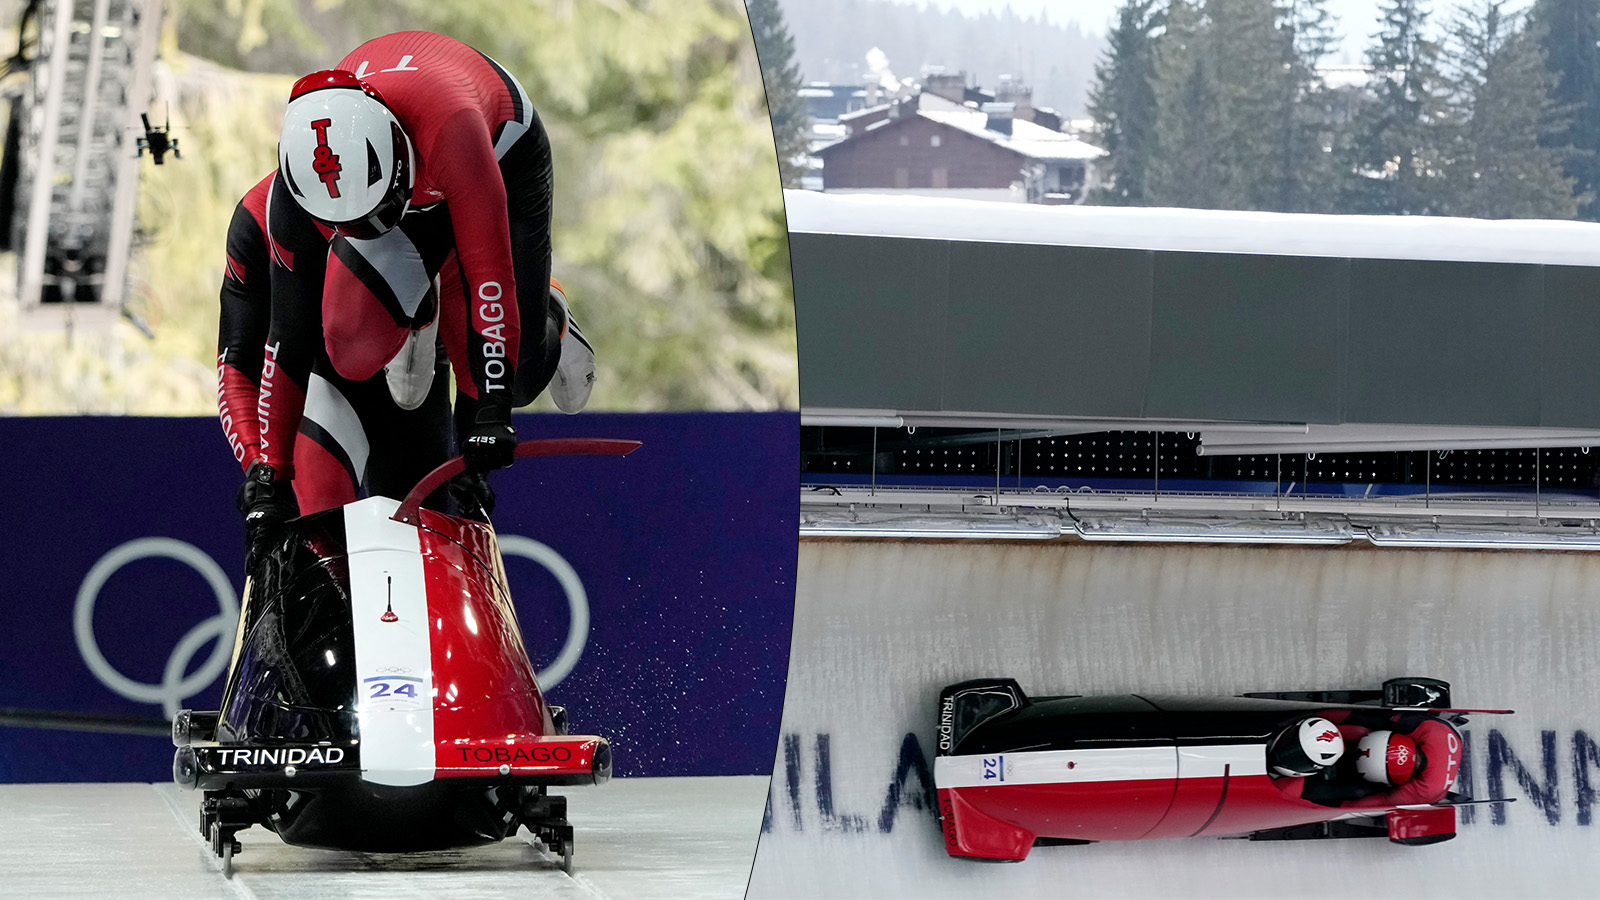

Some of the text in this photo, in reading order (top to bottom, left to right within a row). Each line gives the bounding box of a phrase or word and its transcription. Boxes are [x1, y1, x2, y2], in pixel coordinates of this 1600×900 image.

[310, 117, 343, 199] T&T
[478, 281, 507, 393] TOBAGO
[468, 436, 497, 445] SEIZ
[369, 682, 418, 698] 24
[939, 695, 954, 751] TRINIDAD
[217, 747, 344, 765] TRINIDAD
[457, 746, 572, 763] TOBAGO
[983, 758, 997, 780] 24
[1443, 732, 1459, 791] TTO
[761, 732, 940, 834] ILA
[943, 799, 958, 848] TOBAGO
